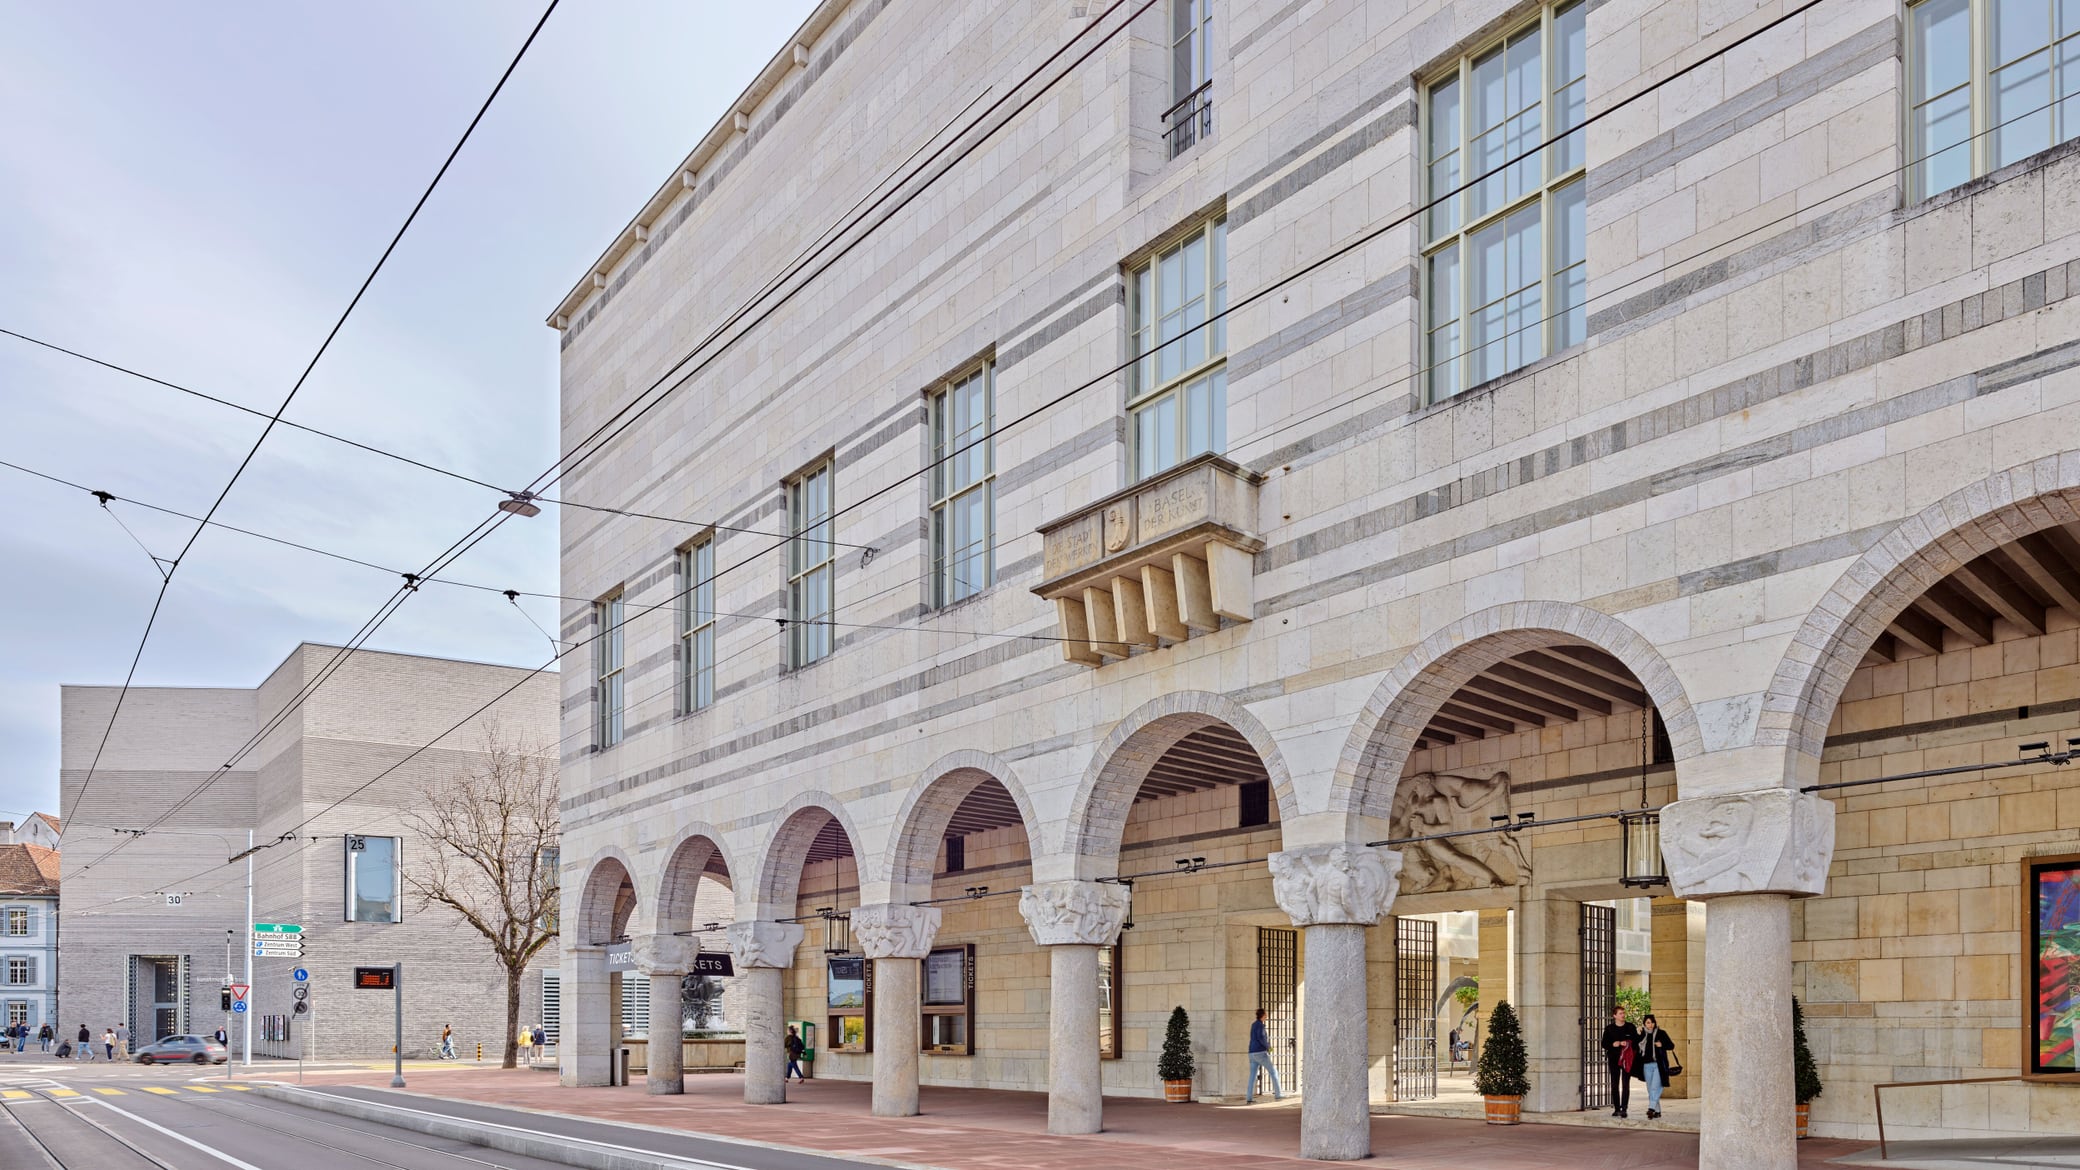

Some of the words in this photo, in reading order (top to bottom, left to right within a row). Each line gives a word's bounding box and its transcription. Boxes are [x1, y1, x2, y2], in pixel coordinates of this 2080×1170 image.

[1154, 487, 1192, 512] BASEL
[1144, 513, 1165, 531] DER
[350, 839, 365, 850] 25
[168, 895, 181, 904] 30
[693, 959, 723, 970] KETS
